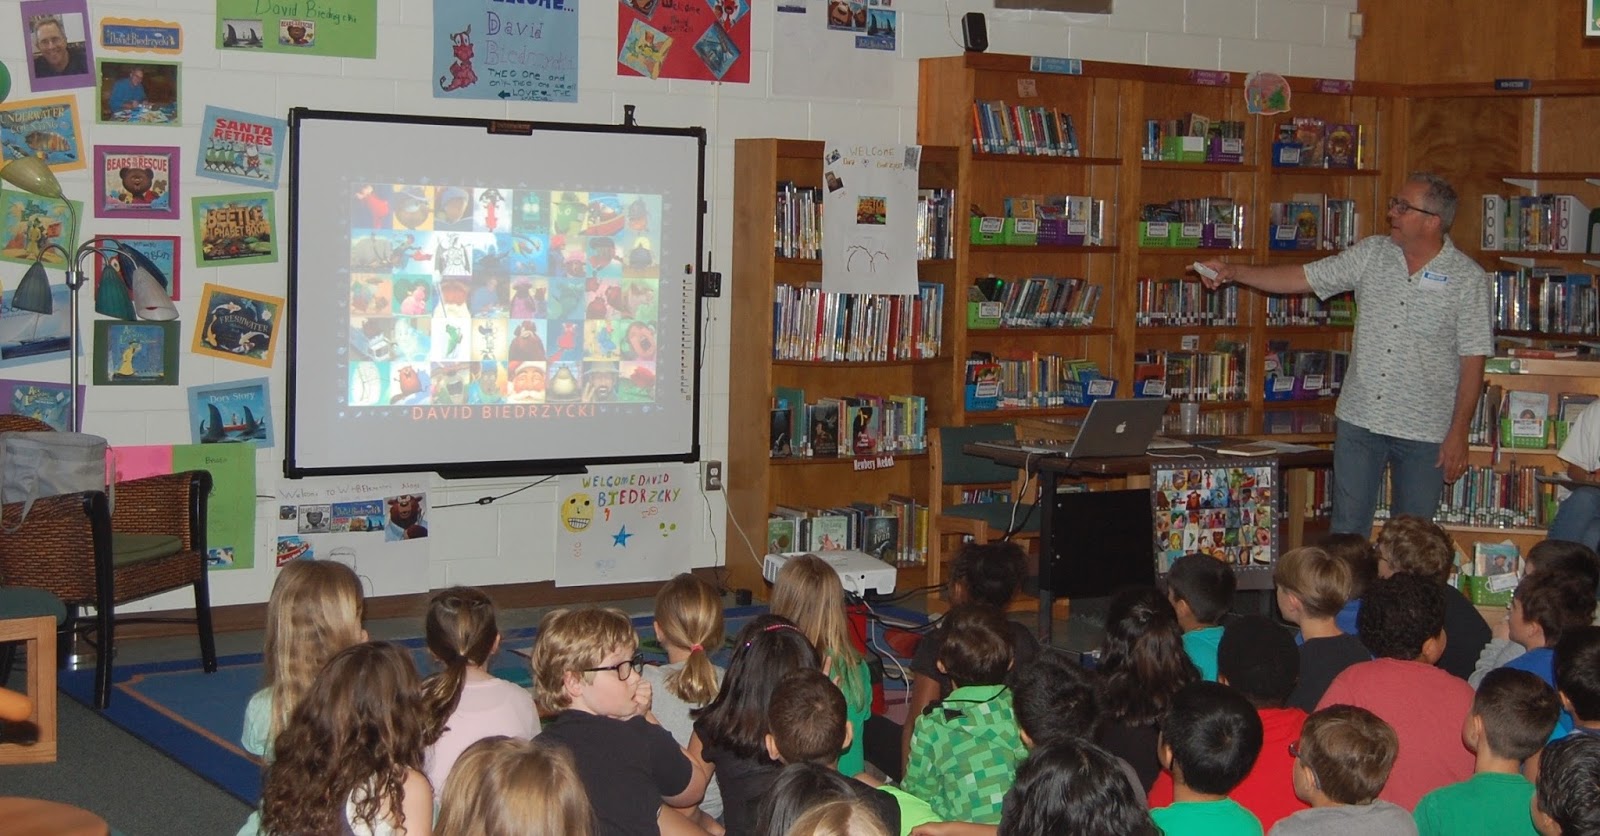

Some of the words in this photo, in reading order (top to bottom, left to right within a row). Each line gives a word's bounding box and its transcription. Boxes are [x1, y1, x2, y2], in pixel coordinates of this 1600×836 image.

[255, 0, 297, 16] David
[486, 11, 544, 39] David
[512, 89, 539, 97] LOVE
[216, 118, 273, 137] SANTA
[213, 127, 273, 146] RETIRES
[106, 157, 131, 171] BEARS
[139, 157, 167, 172] RESCUE
[207, 205, 263, 228] BEETLE
[206, 225, 244, 239] ALPHABET
[219, 314, 269, 333] FRESHWATER
[209, 395, 230, 403] Dory
[232, 392, 256, 401] Story
[412, 406, 472, 420] DAVID
[482, 404, 596, 420] BIEDRZYCKI
[853, 459, 876, 471] Newbery
[876, 455, 895, 469] Medal
[582, 475, 635, 489] WELCOME
[638, 473, 669, 486] DAVID
[598, 488, 681, 507] BIEDRZCKY
